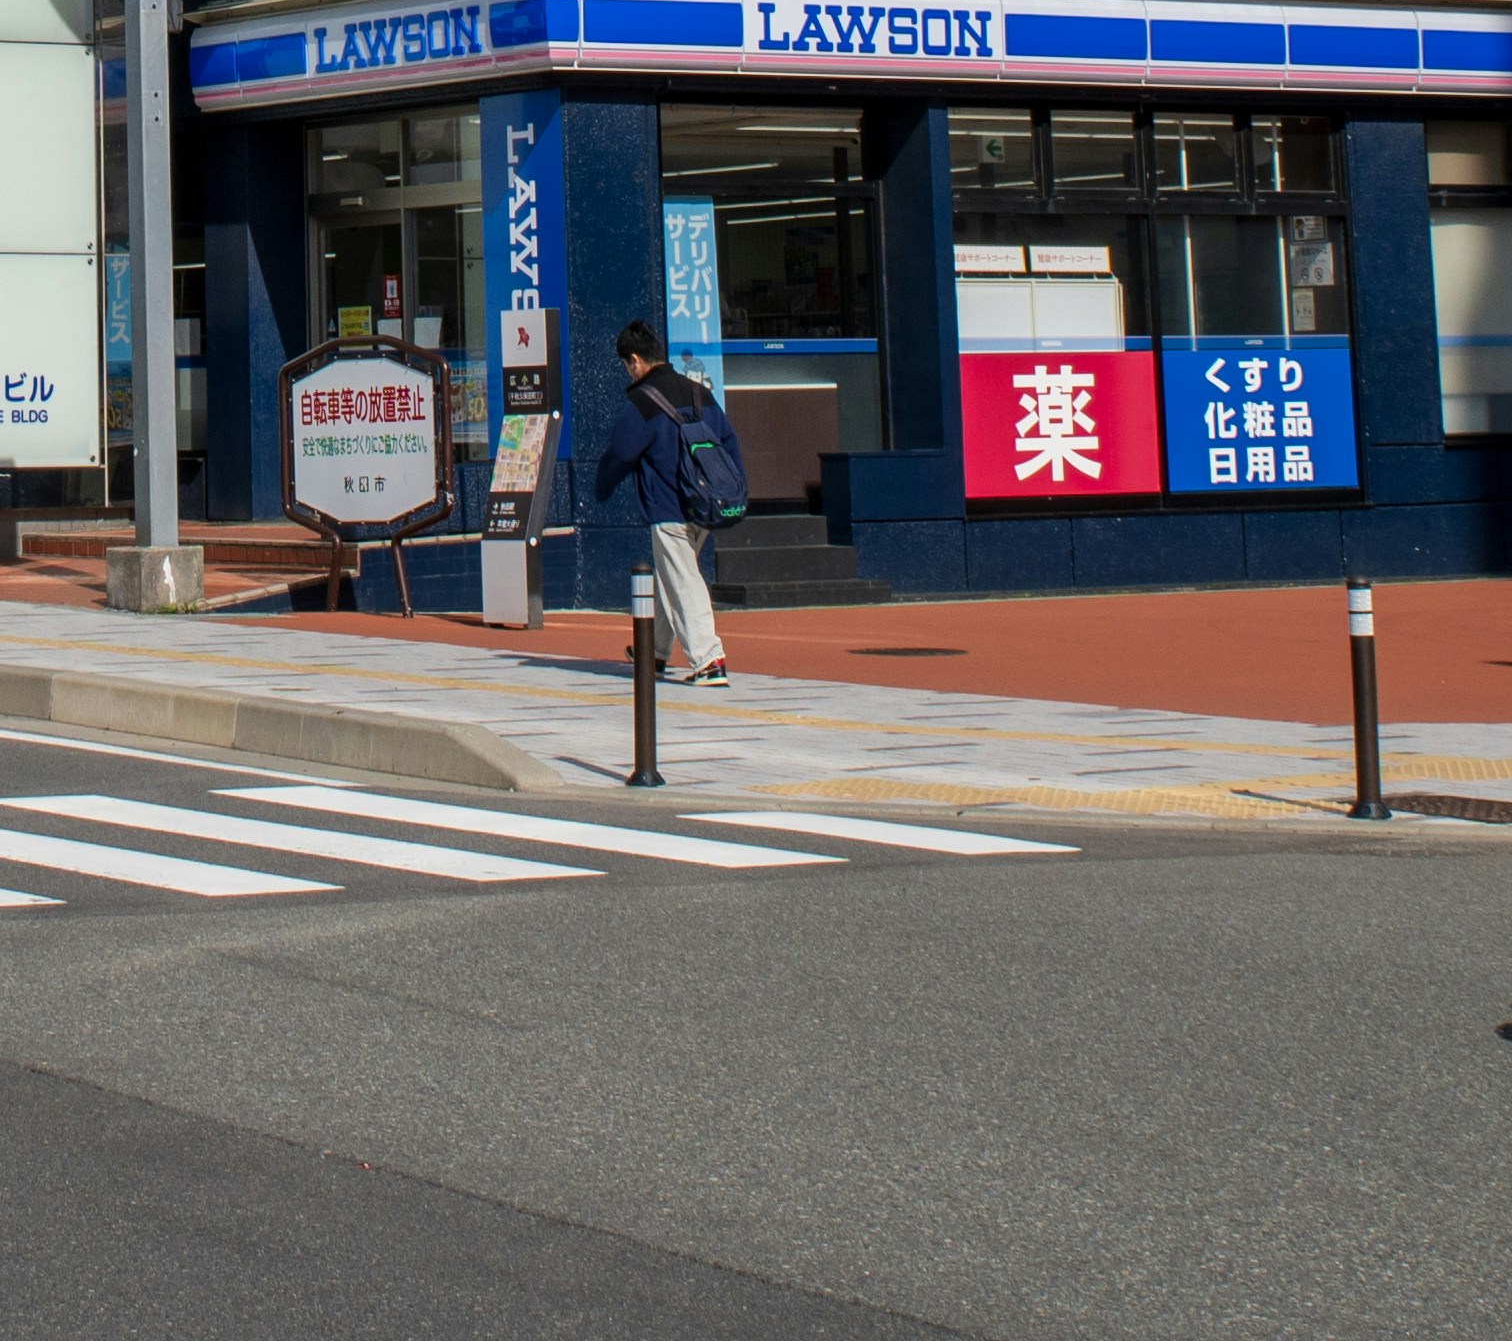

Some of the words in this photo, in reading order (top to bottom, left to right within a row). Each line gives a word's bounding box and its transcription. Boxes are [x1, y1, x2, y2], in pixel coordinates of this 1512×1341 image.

[314, 4, 483, 72] LAWSON
[757, 2, 993, 57] LAWSON
[664, 214, 691, 318] サービス
[687, 215, 714, 344] デリバリー
[110, 255, 129, 345] サービス
[1204, 357, 1304, 393] くすり
[11, 410, 49, 424] BLDG
[300, 385, 427, 427] 自転車等の放置禁止
[1012, 365, 1102, 481] 薬
[1203, 400, 1314, 439] 化粧品
[302, 433, 429, 457] 安全で快適なまちづくりにご協力ください。
[1208, 445, 1314, 484] 日用品
[343, 475, 386, 494] 秋田市
